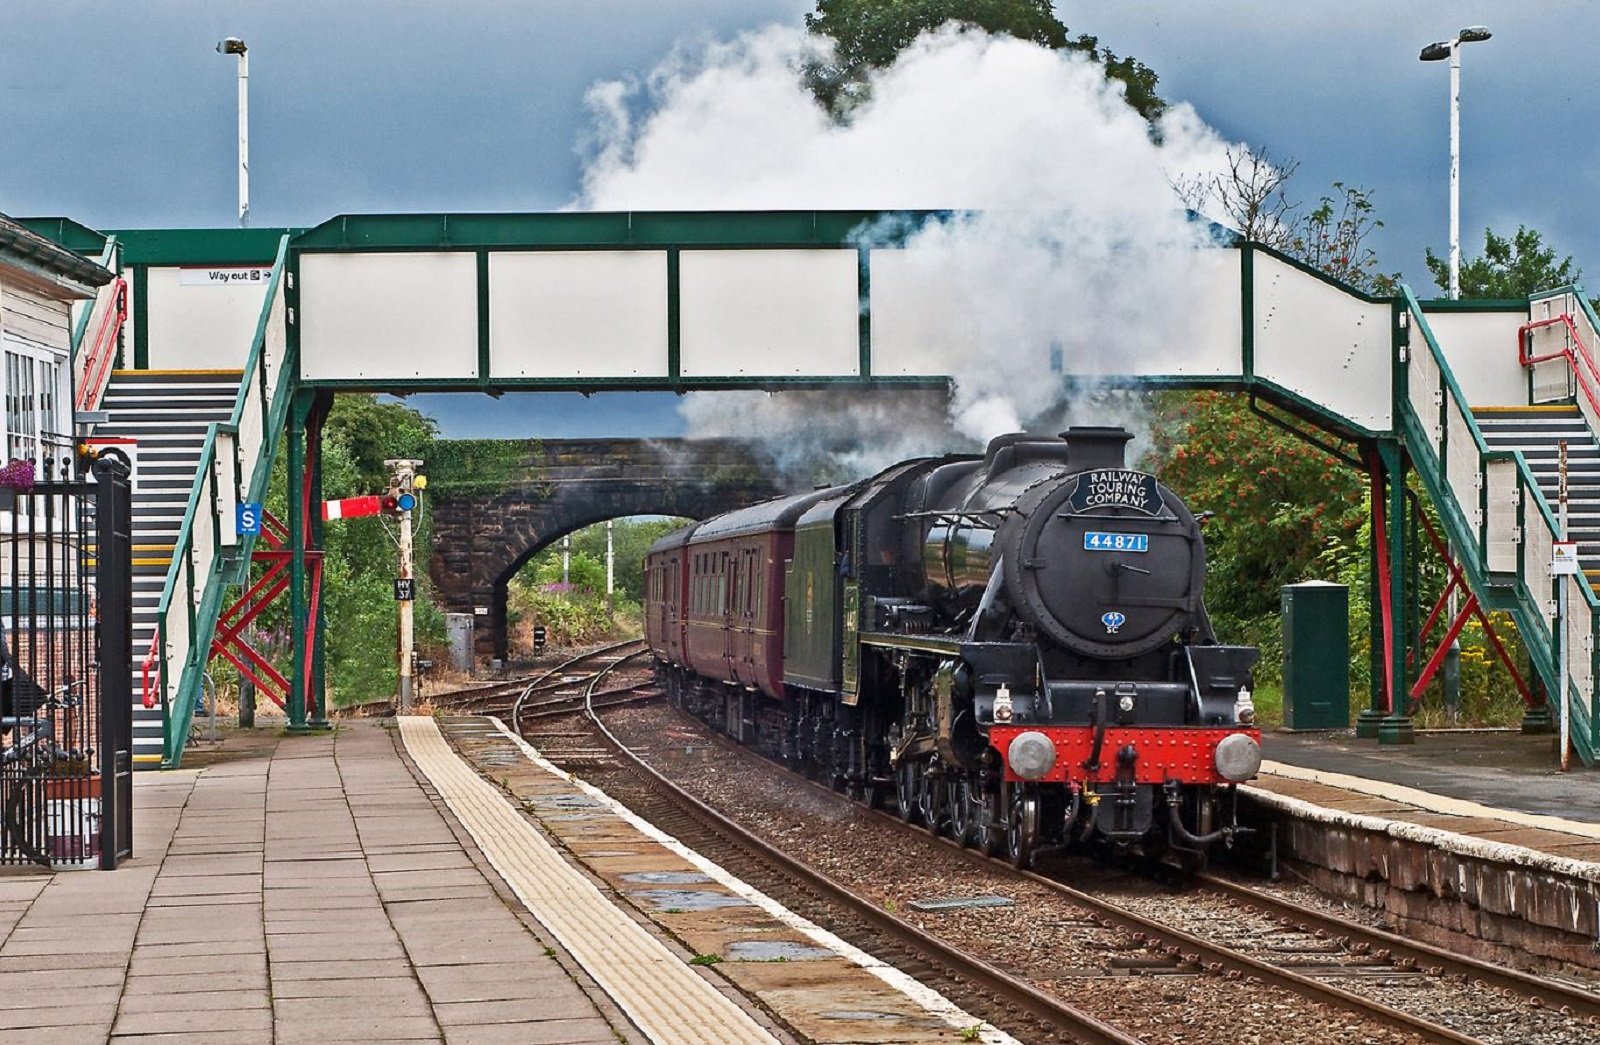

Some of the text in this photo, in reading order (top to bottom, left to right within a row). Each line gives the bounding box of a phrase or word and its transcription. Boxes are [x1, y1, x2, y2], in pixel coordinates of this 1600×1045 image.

[209, 271, 248, 283] Way out
[1090, 471, 1147, 486] RAILWAY
[1088, 482, 1147, 497] TOURING
[1086, 492, 1149, 508] COMPANY
[242, 510, 255, 528] S
[1090, 536, 1142, 550] 44871
[398, 590, 410, 599] 37
[1106, 626, 1119, 634] SC
